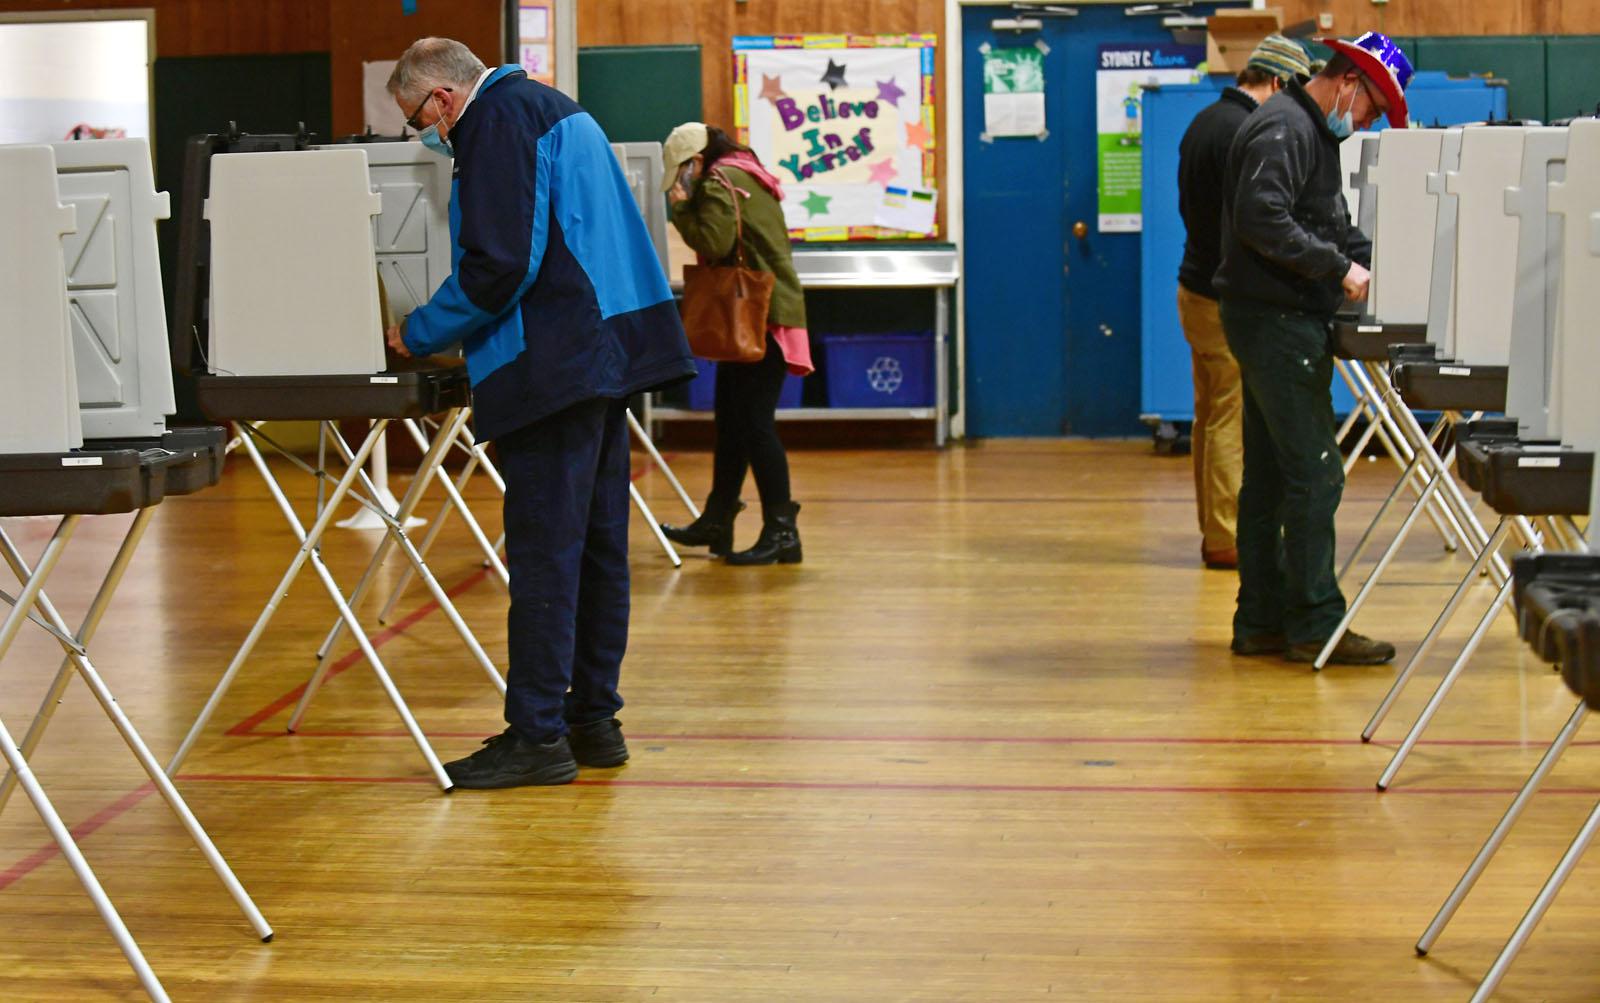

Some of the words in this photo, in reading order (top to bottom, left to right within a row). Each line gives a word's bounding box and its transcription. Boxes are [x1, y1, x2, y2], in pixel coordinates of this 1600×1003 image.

[1102, 50, 1141, 68] SYDNEY
[776, 94, 879, 132] Believe
[778, 127, 875, 182] Yourself
[802, 128, 843, 157] In
